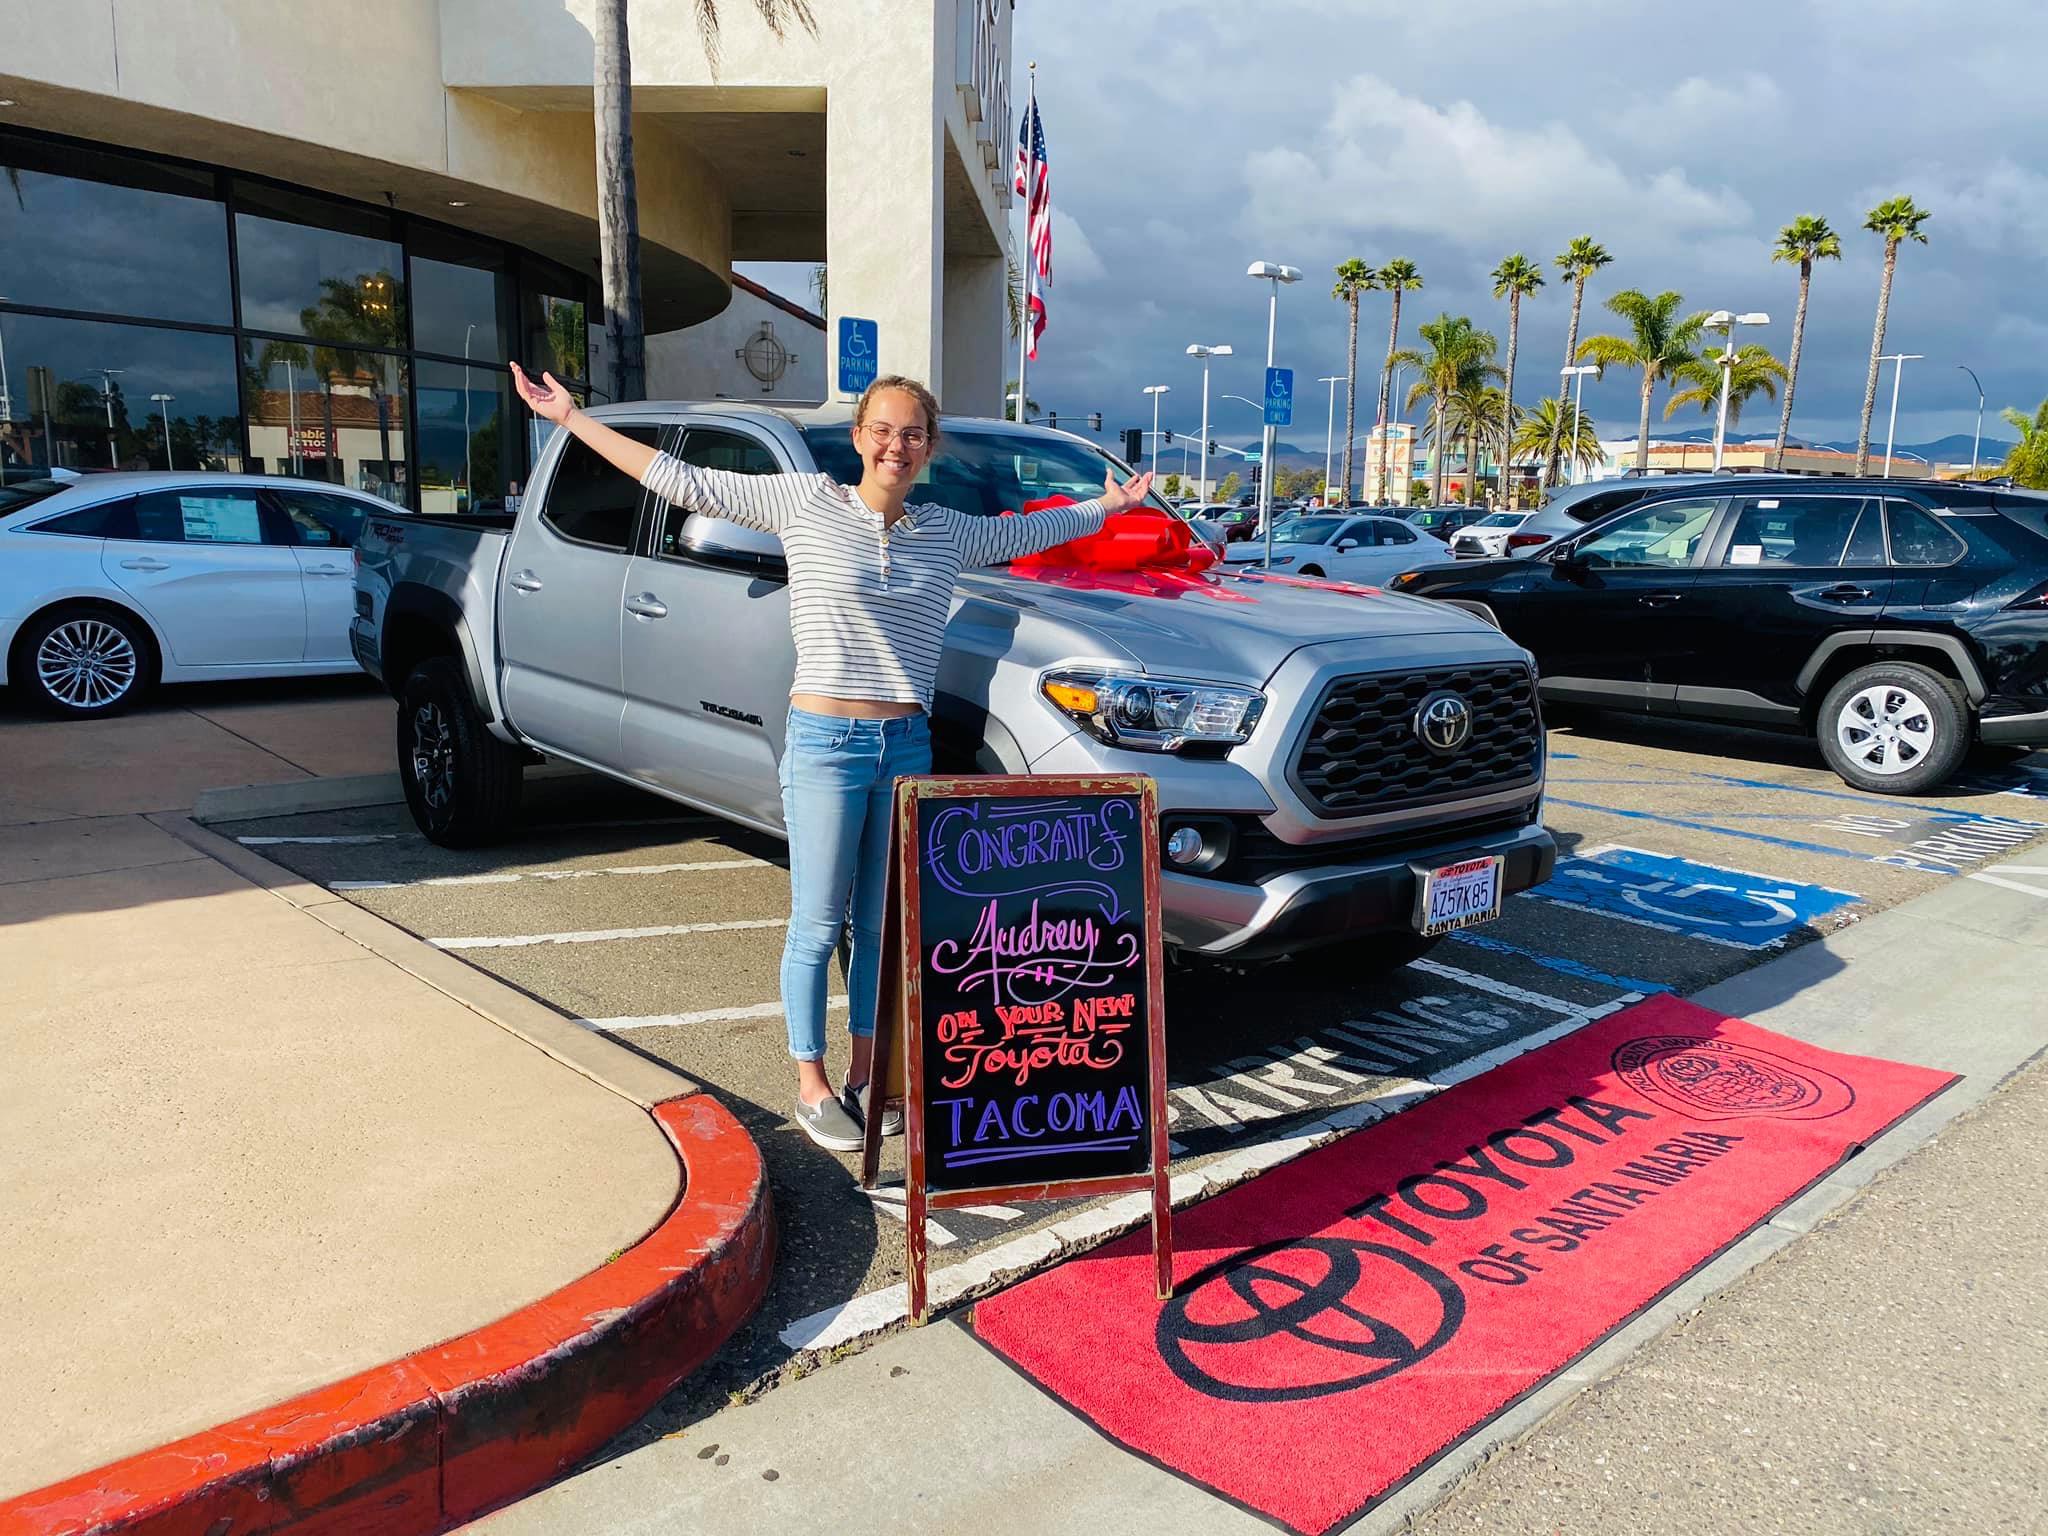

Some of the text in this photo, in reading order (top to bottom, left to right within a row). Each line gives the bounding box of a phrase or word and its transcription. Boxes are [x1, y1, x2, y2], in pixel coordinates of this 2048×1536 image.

[840, 356, 875, 374] PARKING
[847, 374, 869, 389] ONLY
[1265, 398, 1291, 410] PARKING
[699, 700, 763, 727] TACOMA
[1810, 813, 1911, 838] NO
[1864, 815, 2048, 875] PARKING
[1453, 861, 1489, 874] TOYOTA
[1430, 881, 1488, 919] AZ57K85
[1426, 909, 1497, 936] SANTA MARIA
[932, 898, 1138, 1004] Audrey
[941, 1032, 1123, 1088] Toyota
[931, 1085, 1144, 1146] TACOMA
[1345, 1096, 1657, 1246] TOYOTA
[1458, 1131, 1745, 1286] OF SANTA MARIA
